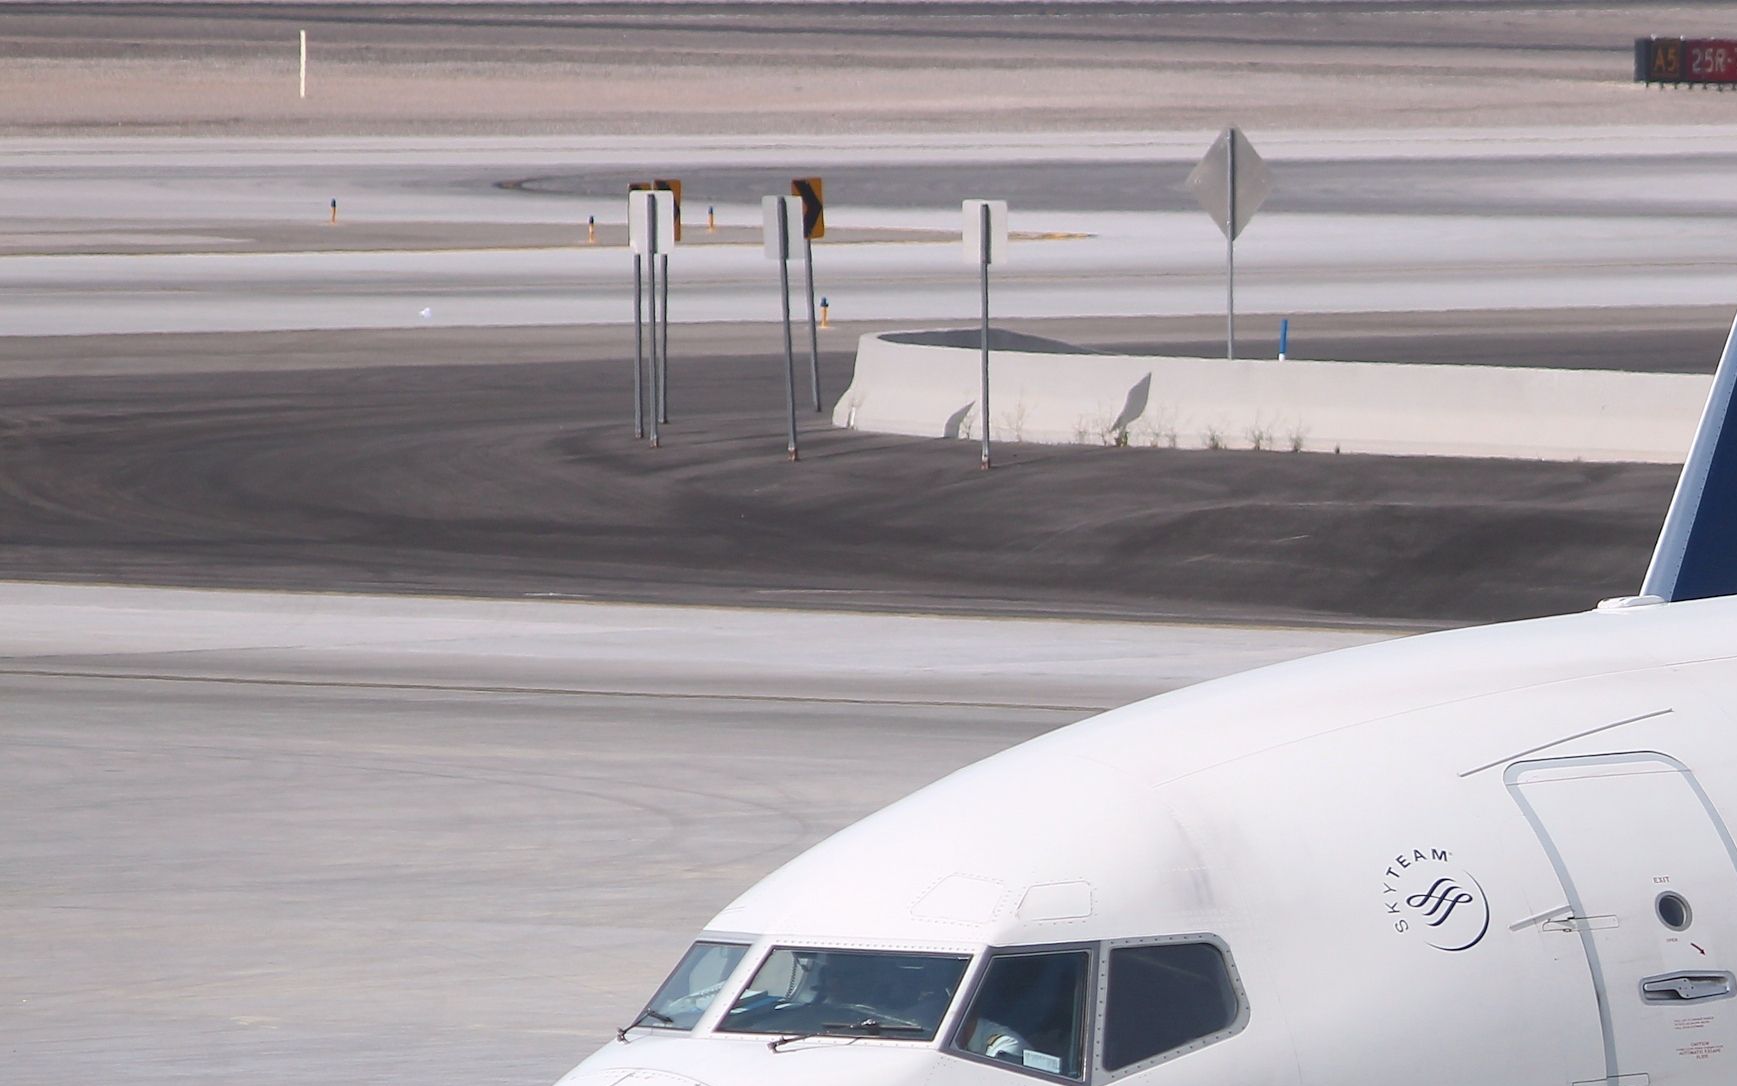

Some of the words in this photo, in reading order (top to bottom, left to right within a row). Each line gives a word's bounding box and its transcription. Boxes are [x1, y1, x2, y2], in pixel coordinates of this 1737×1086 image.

[1654, 48, 1678, 72] A5
[1383, 848, 1449, 933] SKYTEAM
[1653, 876, 1670, 884] EXIT
